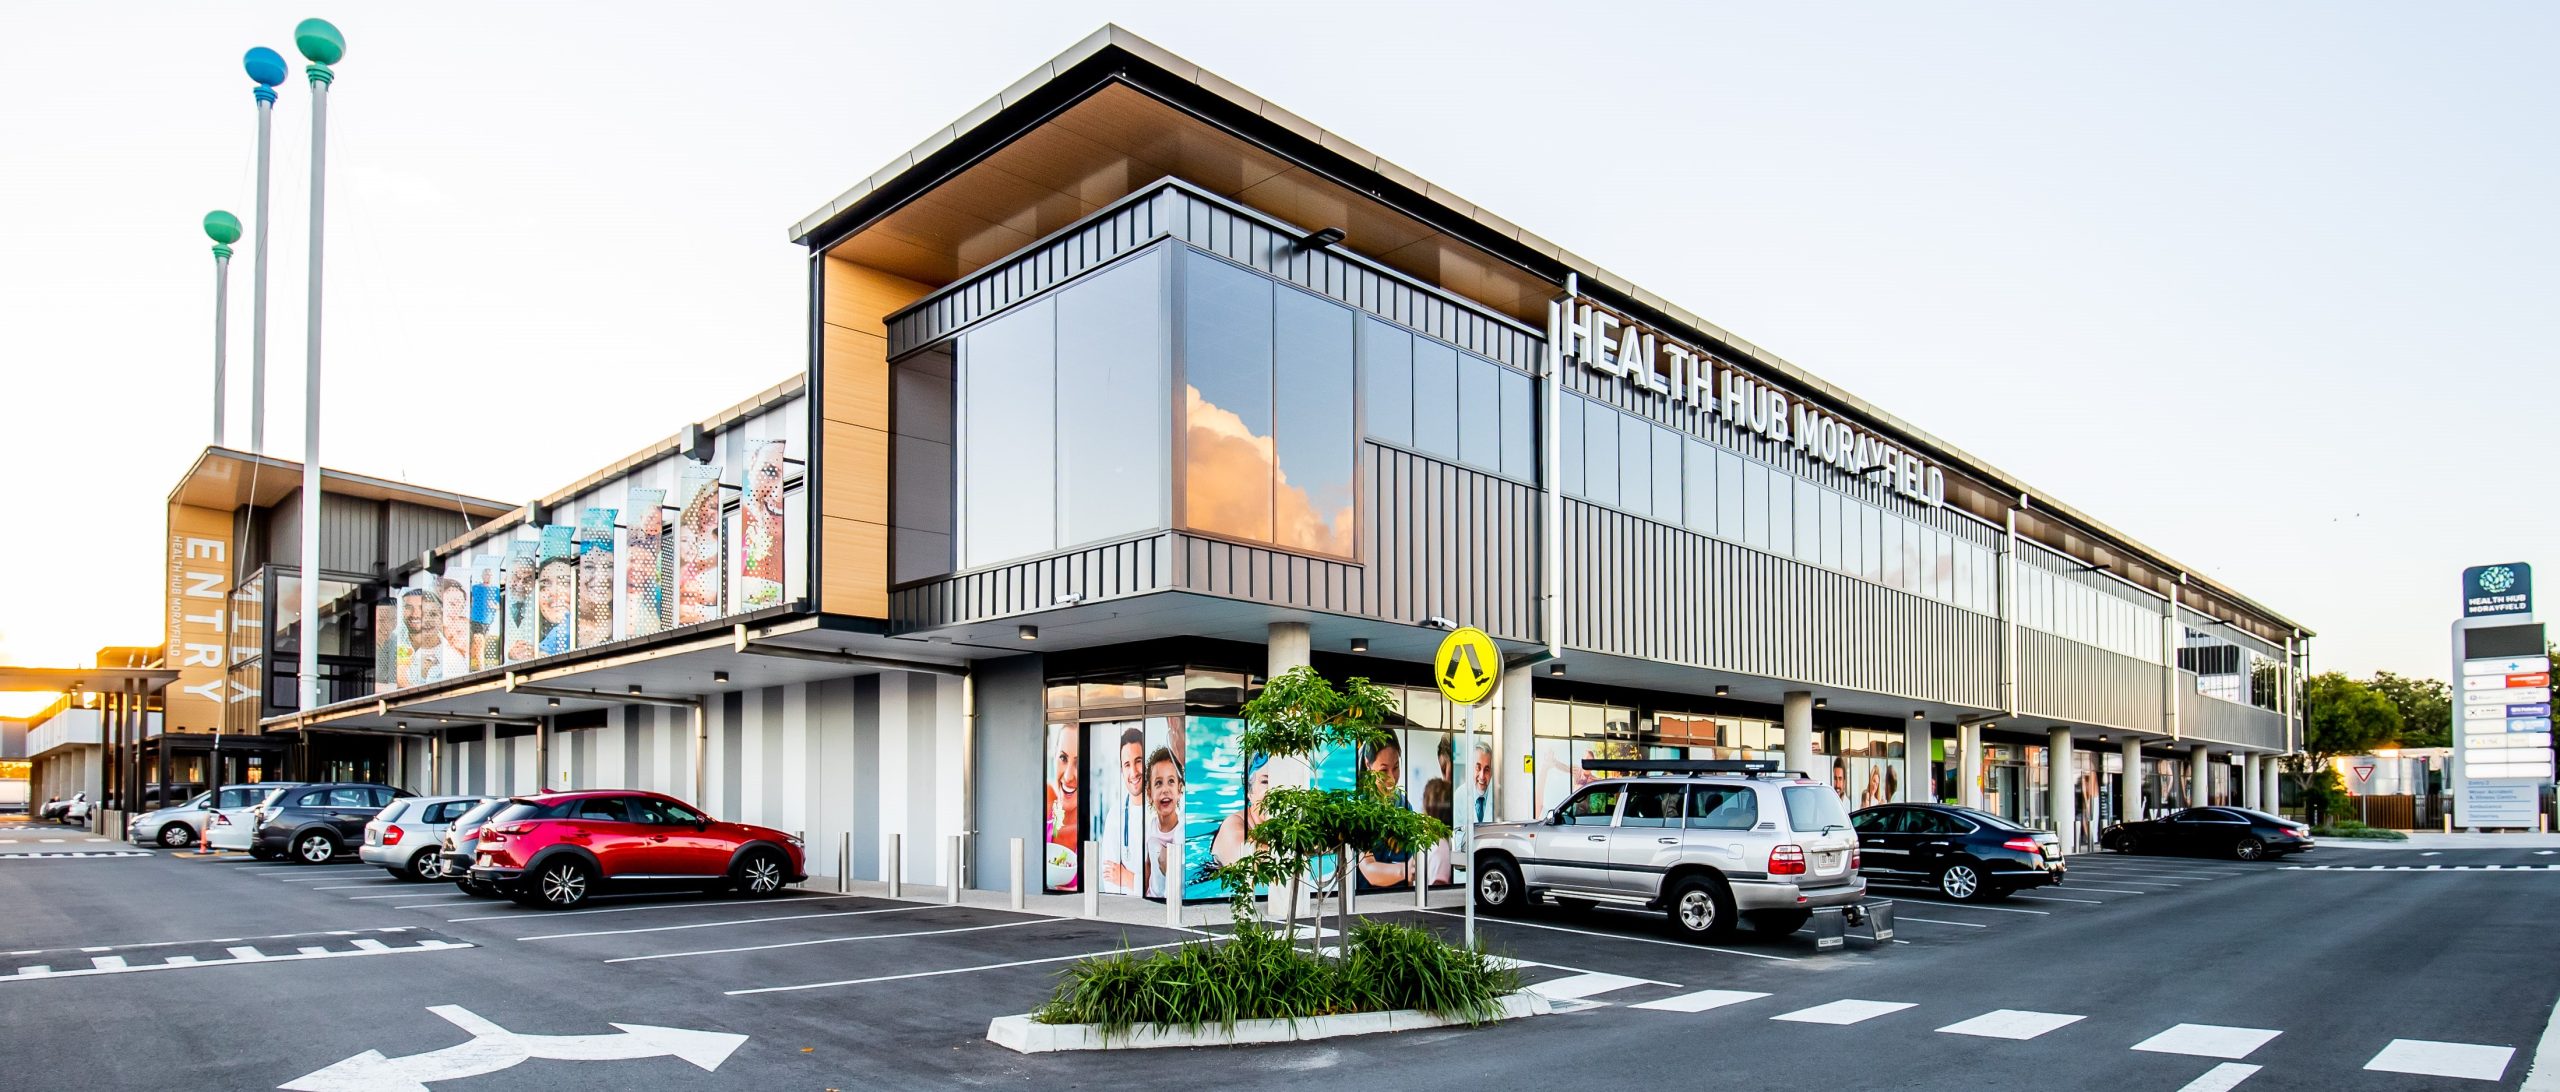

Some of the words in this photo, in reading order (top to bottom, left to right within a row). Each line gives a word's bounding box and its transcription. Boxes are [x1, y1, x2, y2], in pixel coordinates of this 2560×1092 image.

[1561, 297, 1713, 413] HEALTH
[1720, 368, 1789, 443] HUB
[1793, 402, 1945, 509] MORAYFIELD
[173, 535, 183, 573] HEALTH
[171, 575, 183, 594] HUB
[2468, 596, 2504, 605] HEALTH
[2505, 594, 2526, 602] HUB
[183, 536, 225, 703] ENTRY
[2468, 602, 2526, 613] MORAYFIELD
[170, 597, 182, 657] MORAYFIELD
